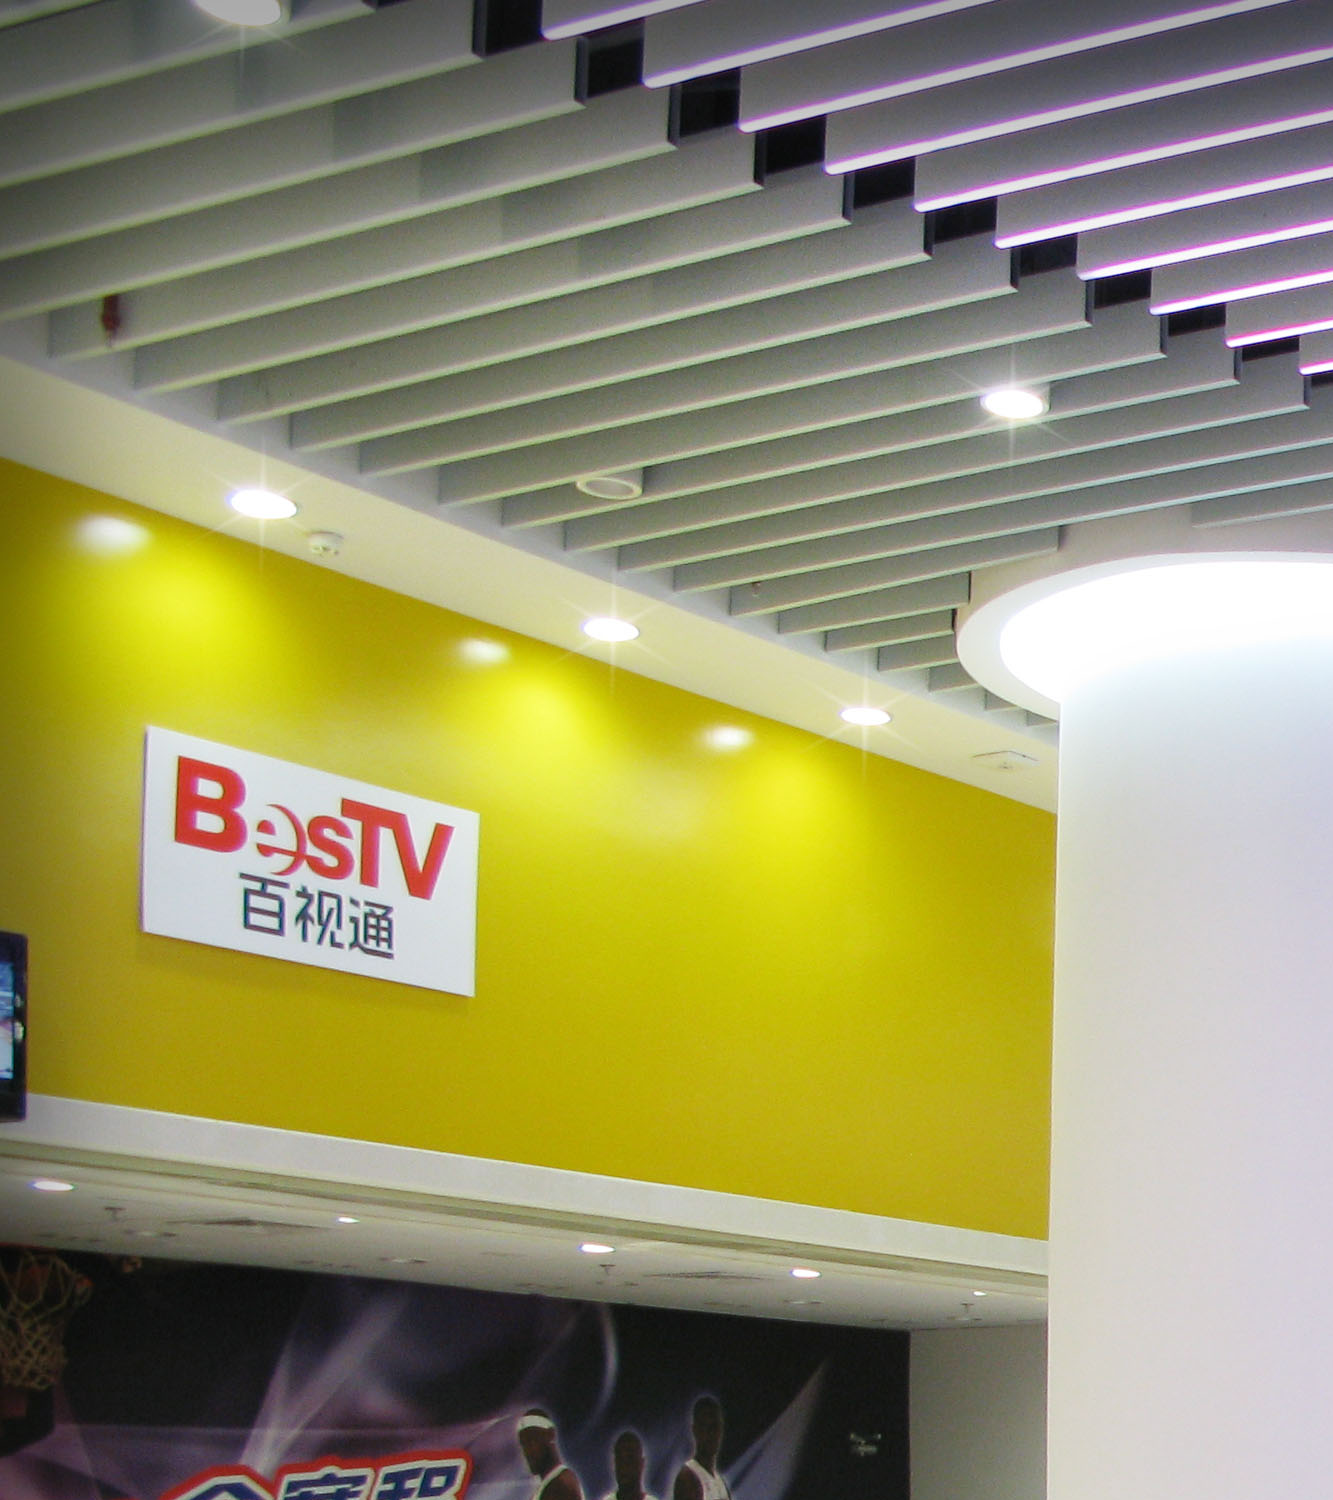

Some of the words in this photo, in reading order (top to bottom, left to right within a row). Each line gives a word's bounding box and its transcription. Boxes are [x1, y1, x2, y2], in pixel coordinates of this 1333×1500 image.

[174, 755, 455, 901] BesTV
[238, 871, 396, 960] 百视通
